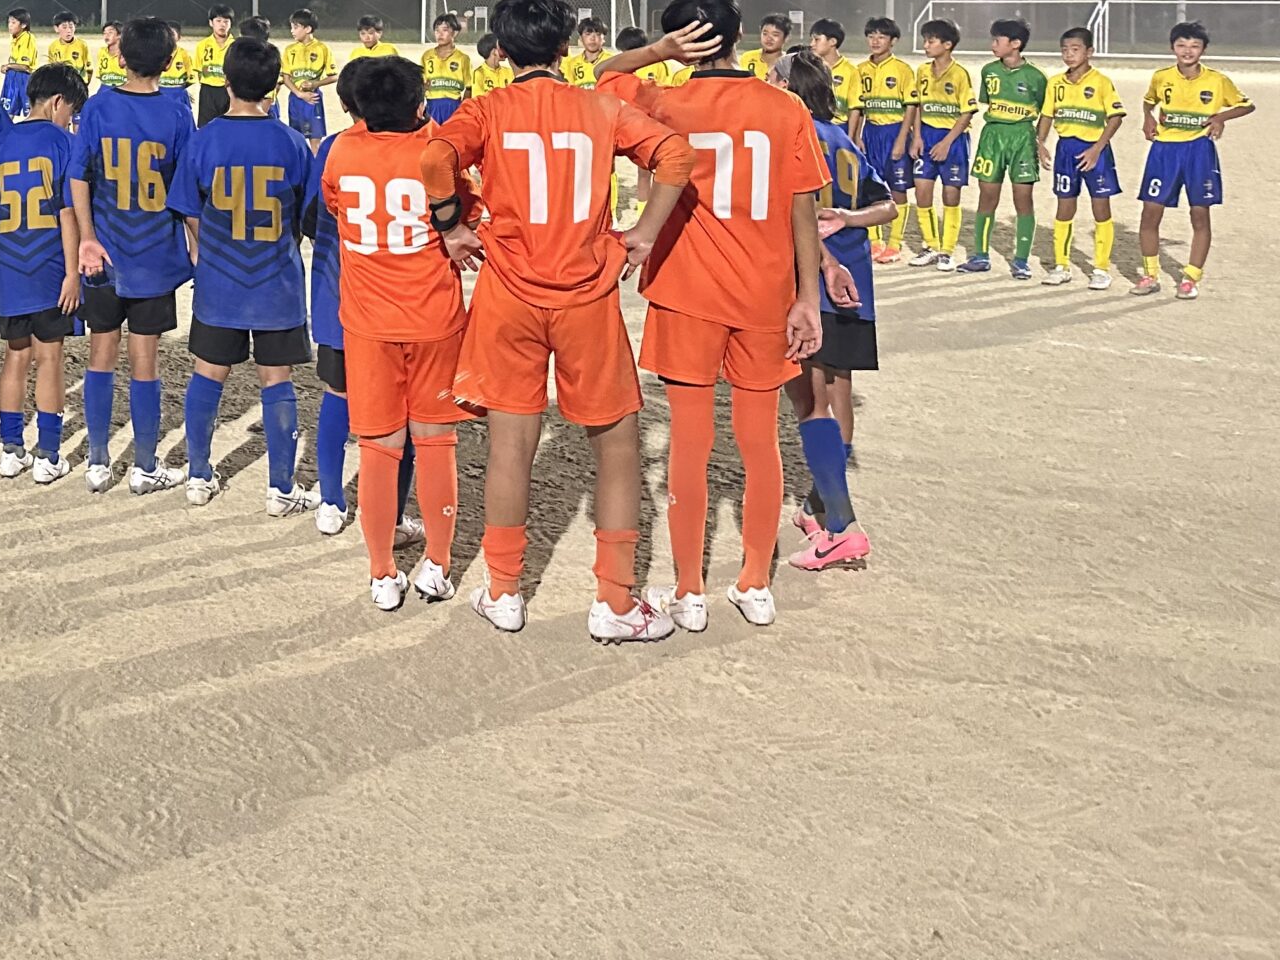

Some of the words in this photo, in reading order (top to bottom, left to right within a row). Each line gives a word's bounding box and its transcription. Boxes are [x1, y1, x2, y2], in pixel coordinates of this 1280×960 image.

[204, 47, 214, 62] 24
[291, 52, 296, 66] 7
[428, 60, 434, 74] 3
[985, 77, 1001, 95] 30
[1054, 85, 1065, 103] 10
[1164, 88, 1172, 105] 6
[102, 137, 167, 213] 46
[688, 130, 771, 221] 71
[973, 156, 994, 177] 30
[503, 131, 593, 225] 77
[1056, 173, 1071, 193] 10
[1148, 178, 1162, 197] 6
[212, 166, 285, 243] 45
[339, 175, 429, 256] 38
